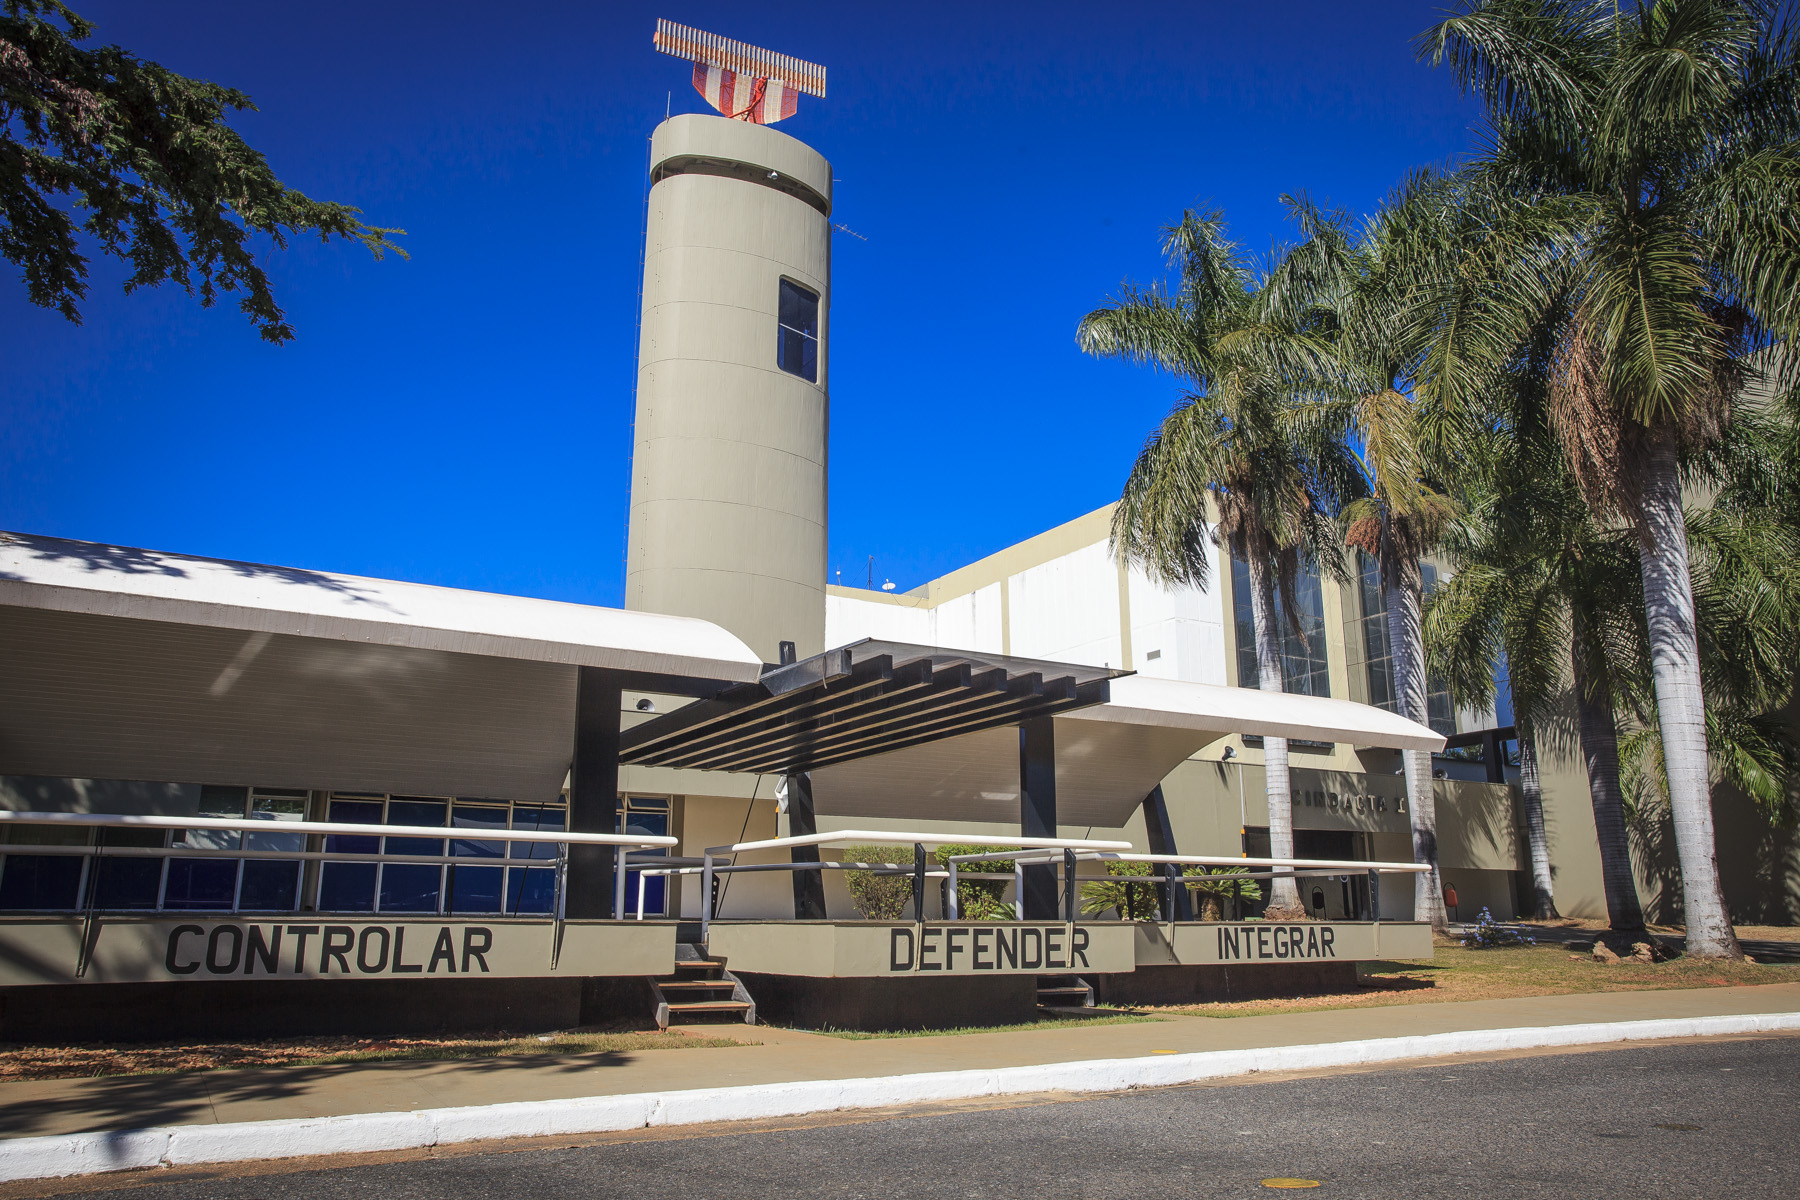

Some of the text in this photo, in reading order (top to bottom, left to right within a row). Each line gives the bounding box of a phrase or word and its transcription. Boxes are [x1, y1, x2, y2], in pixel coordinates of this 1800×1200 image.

[1291, 789, 1386, 812] CINDACTA
[165, 924, 493, 975] CONTROLAR
[890, 927, 1090, 971] DEFENDER
[1217, 926, 1335, 960] INTEGRAR
